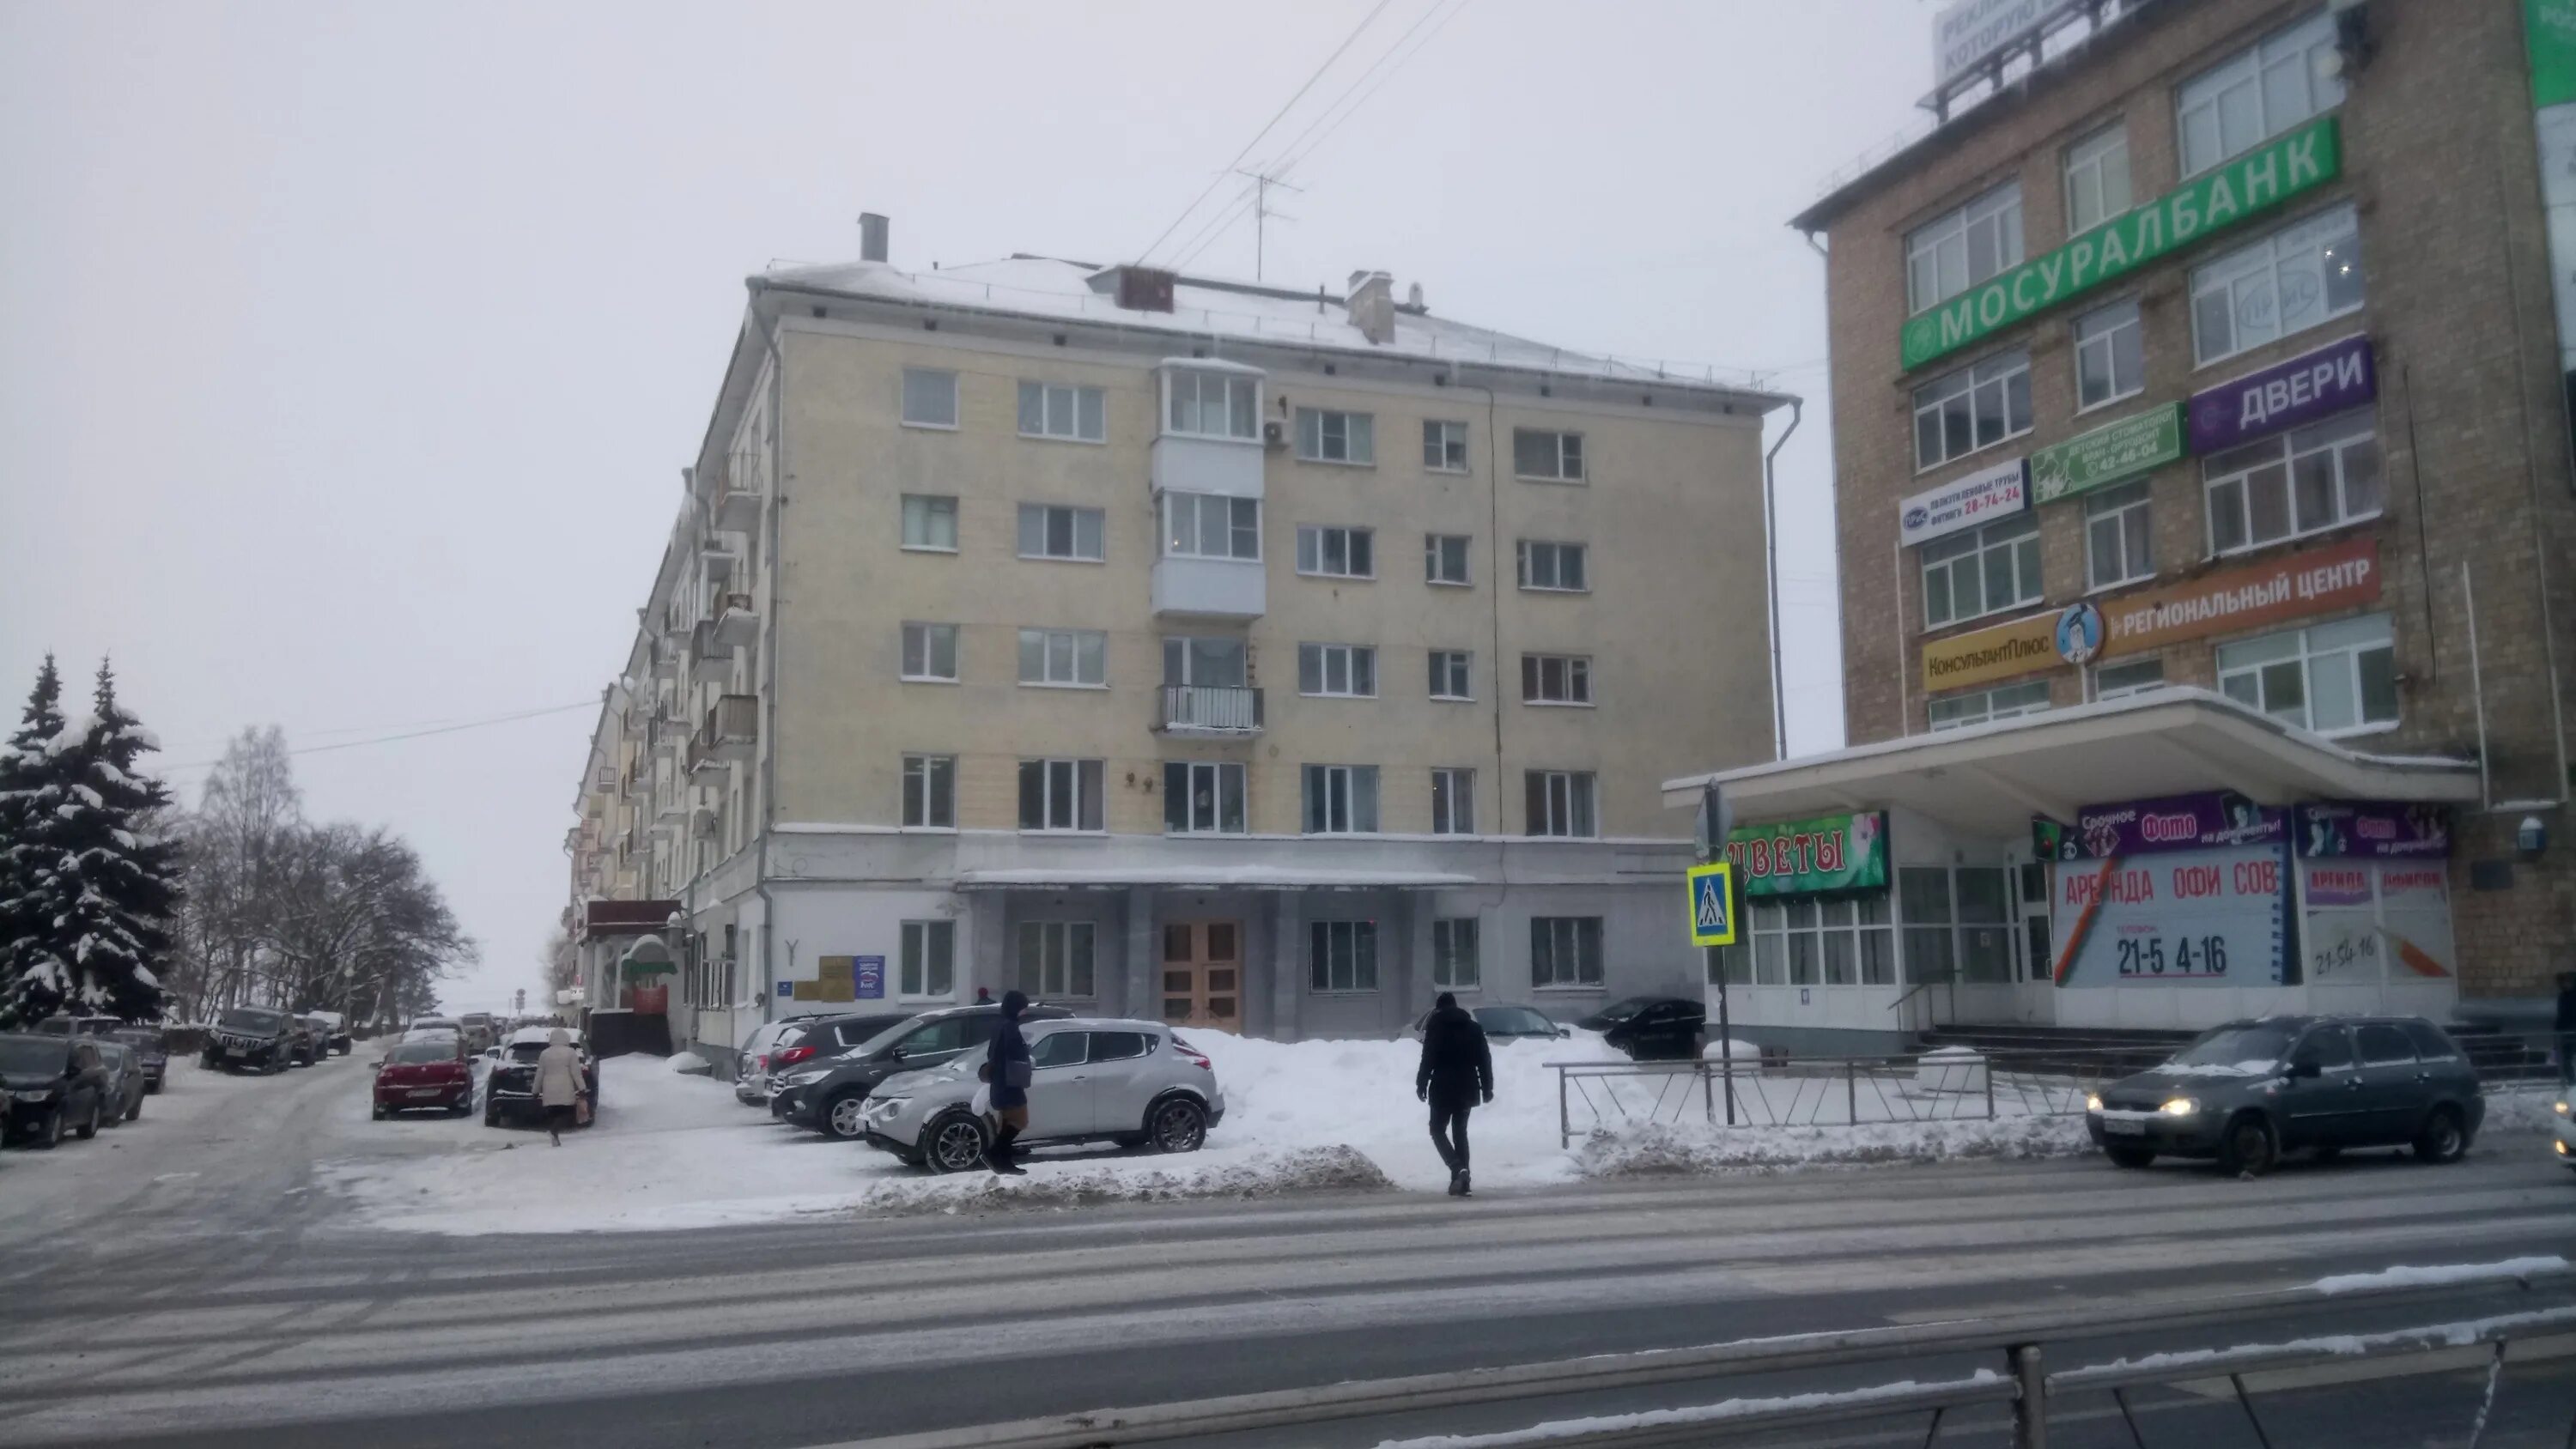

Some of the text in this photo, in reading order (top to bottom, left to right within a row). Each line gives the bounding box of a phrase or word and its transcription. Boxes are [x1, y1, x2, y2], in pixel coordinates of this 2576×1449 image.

[1941, 130, 2320, 349] МОСУРАЛБАНК
[2240, 350, 2362, 429] ДВЕРИ
[1965, 486, 2020, 515] 28-74-24
[2123, 559, 2370, 637] РЕГИОНАЛЬНЫЙ ЦЕНТР
[2082, 809, 2136, 830] Срочное
[2142, 814, 2197, 842] Фото
